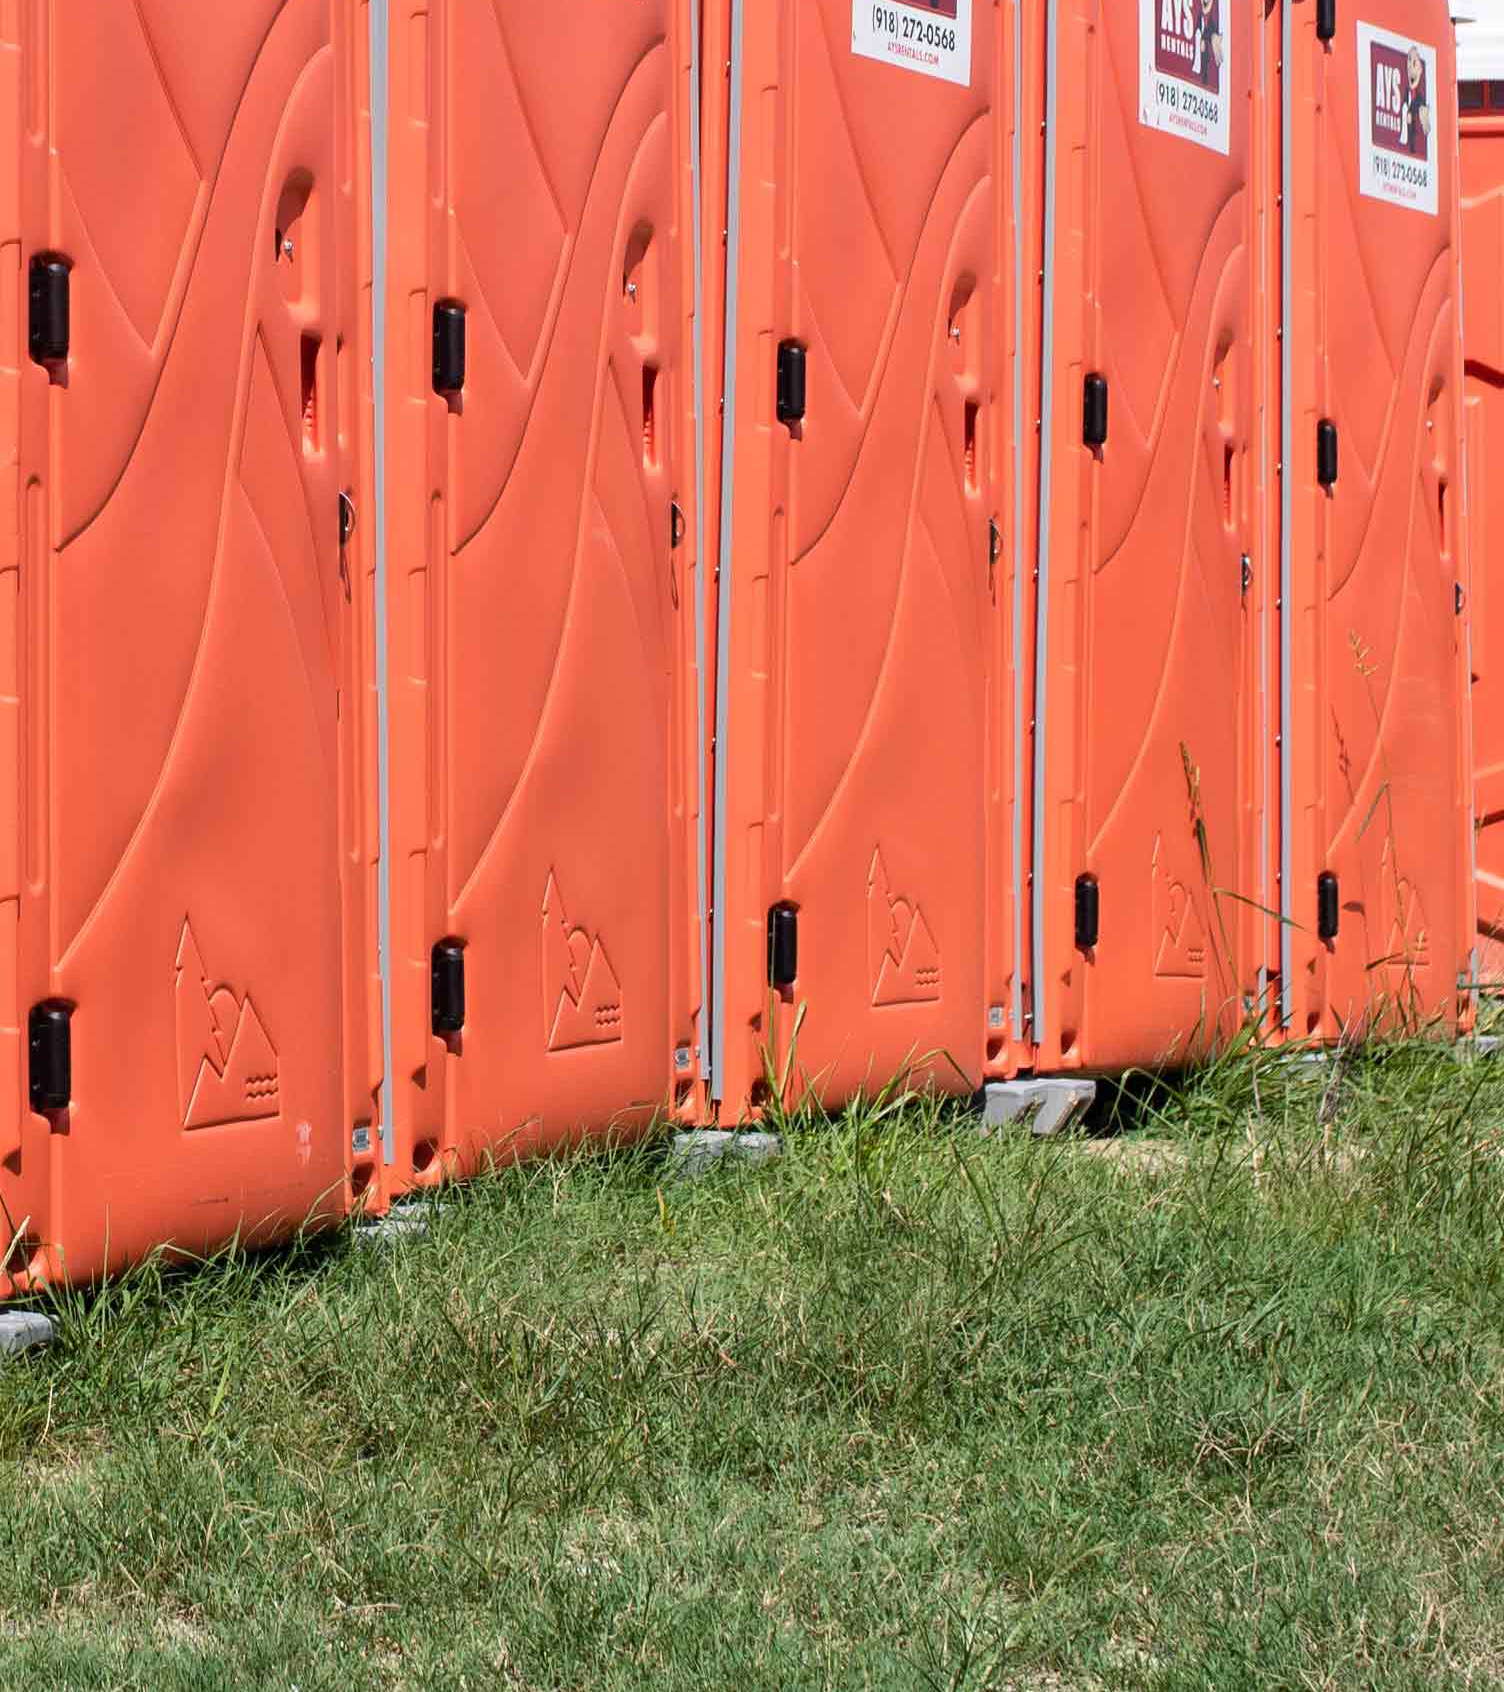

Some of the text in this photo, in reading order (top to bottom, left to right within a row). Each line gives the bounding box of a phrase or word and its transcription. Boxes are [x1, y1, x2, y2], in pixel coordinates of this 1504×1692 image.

[872, 4, 955, 51] (918) 272-0568
[1155, 81, 1218, 124] (918) 272-0568
[1376, 62, 1401, 114] AYS
